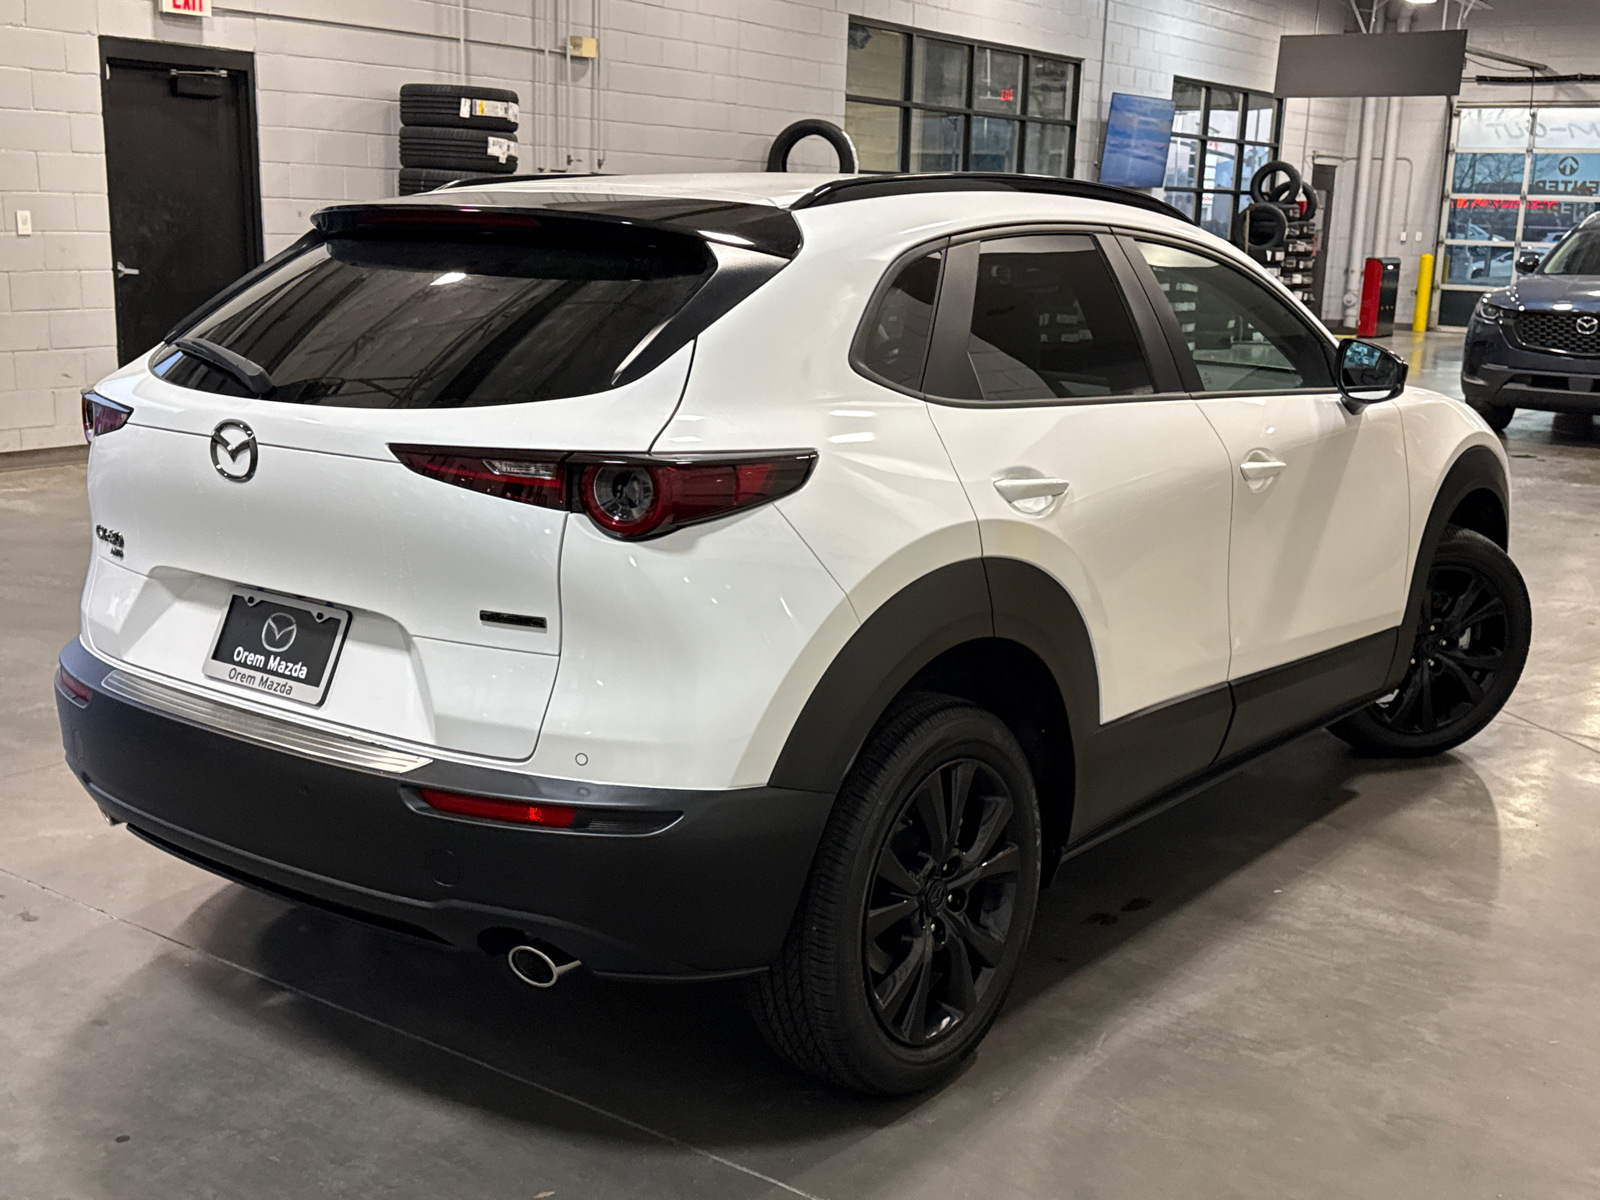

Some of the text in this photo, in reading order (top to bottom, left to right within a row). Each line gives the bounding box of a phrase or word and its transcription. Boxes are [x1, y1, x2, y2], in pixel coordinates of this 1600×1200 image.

[233, 646, 308, 679] Orem Mazda
[228, 667, 293, 696] Orem Mazda
